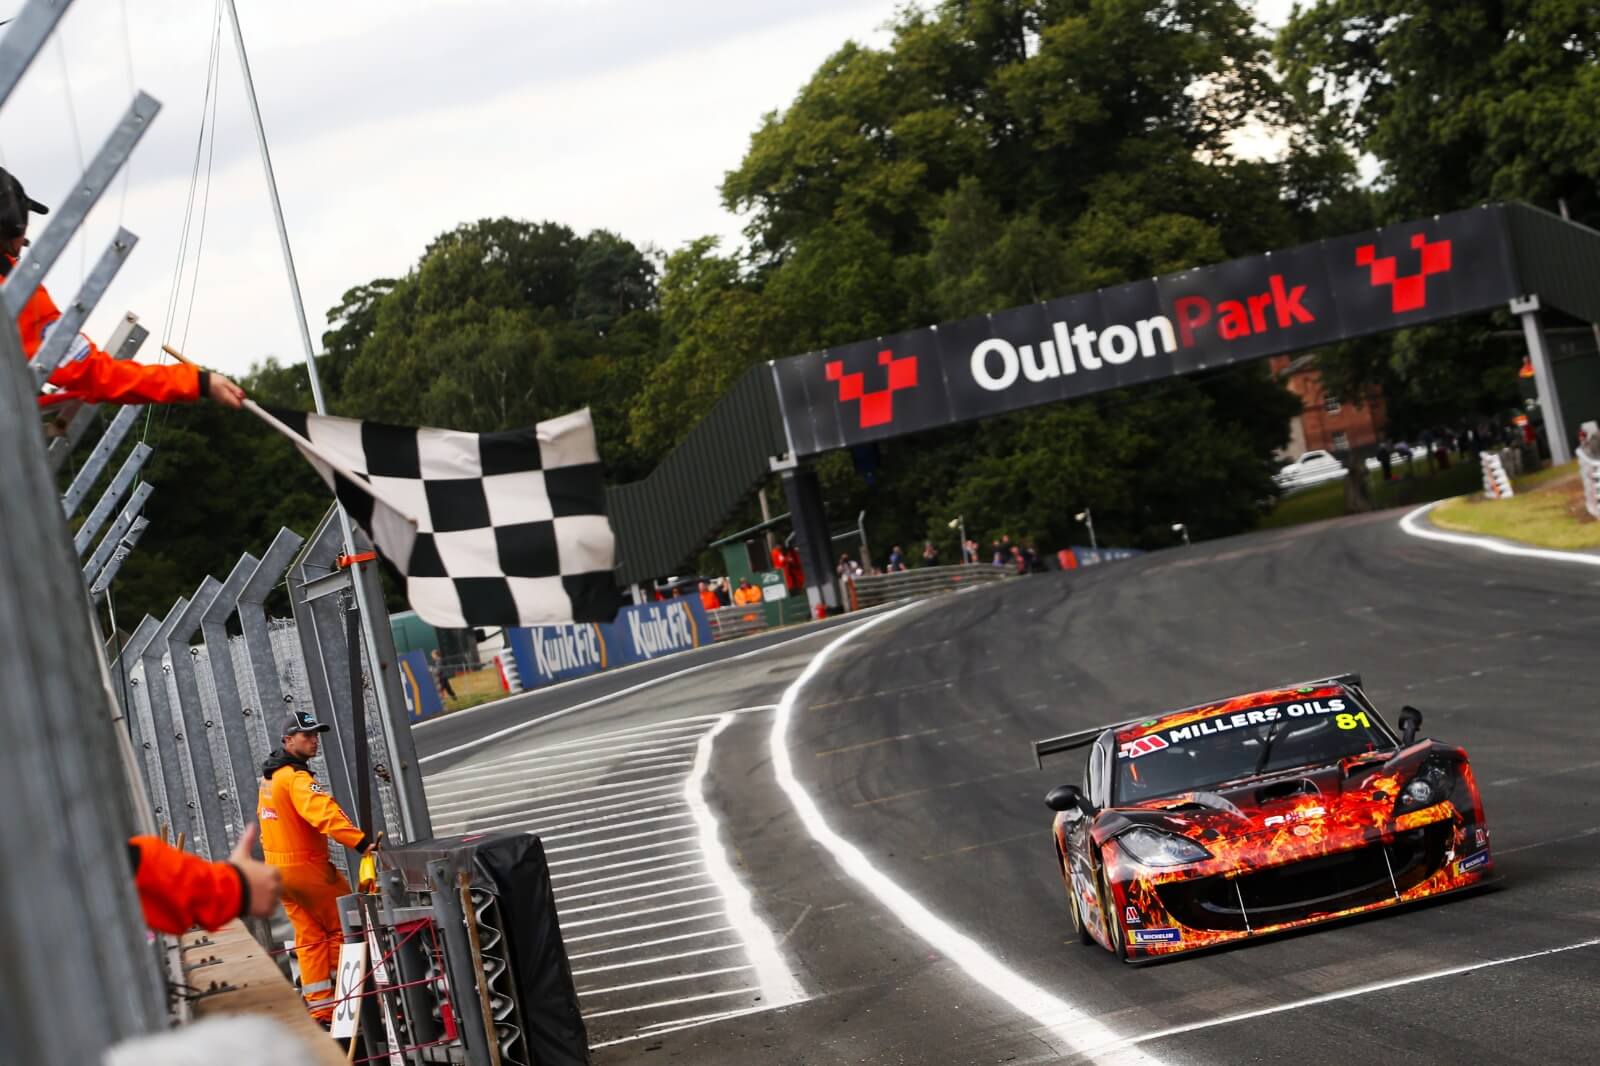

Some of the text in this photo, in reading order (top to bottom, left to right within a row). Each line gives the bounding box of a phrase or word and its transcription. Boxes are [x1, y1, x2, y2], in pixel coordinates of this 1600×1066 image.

[627, 601, 692, 659] KwikFit
[1170, 699, 1346, 743] MILLERS OILS
[1335, 711, 1371, 730] 81
